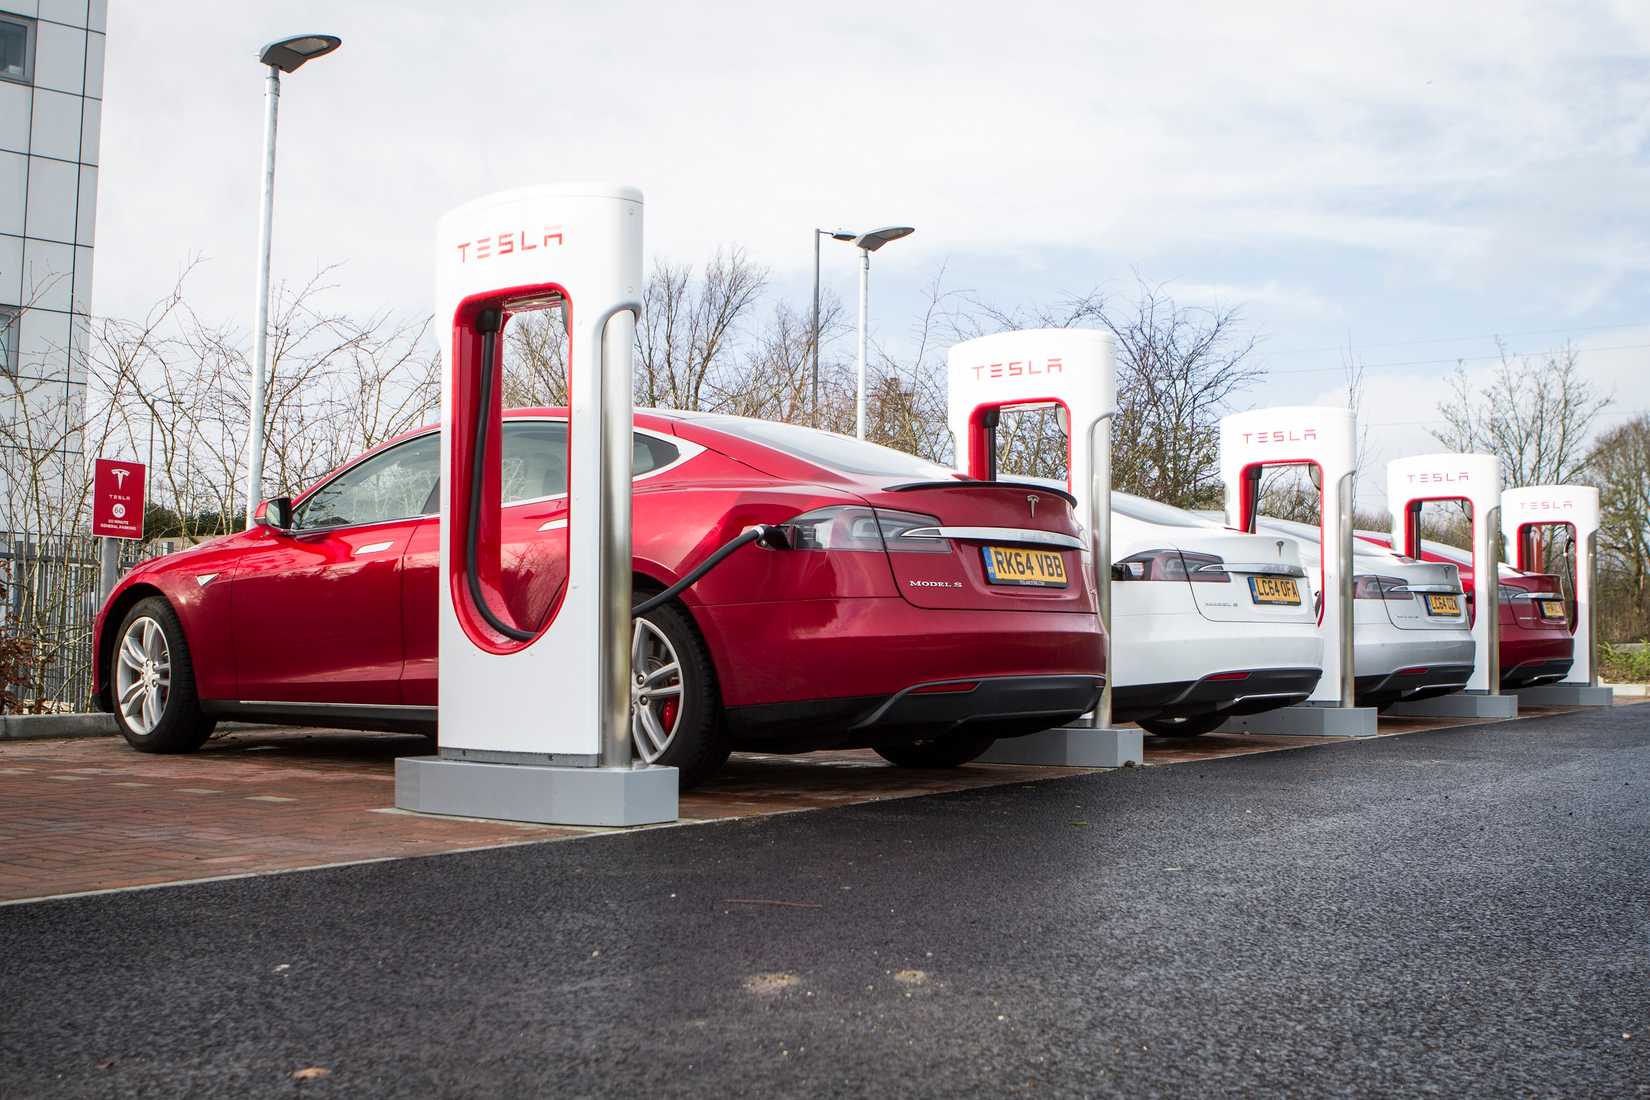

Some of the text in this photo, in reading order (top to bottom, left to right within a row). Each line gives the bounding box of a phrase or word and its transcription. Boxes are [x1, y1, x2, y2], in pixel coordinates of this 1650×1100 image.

[457, 224, 563, 264] TESLA
[970, 358, 1062, 381] TESLA
[1242, 428, 1316, 445] TESLA
[1406, 471, 1469, 484] TESLA
[1519, 500, 1573, 511] TESLA
[994, 550, 1064, 578] RK64 VBB
[909, 580, 951, 588] MODEL
[1255, 578, 1281, 597] LC64
